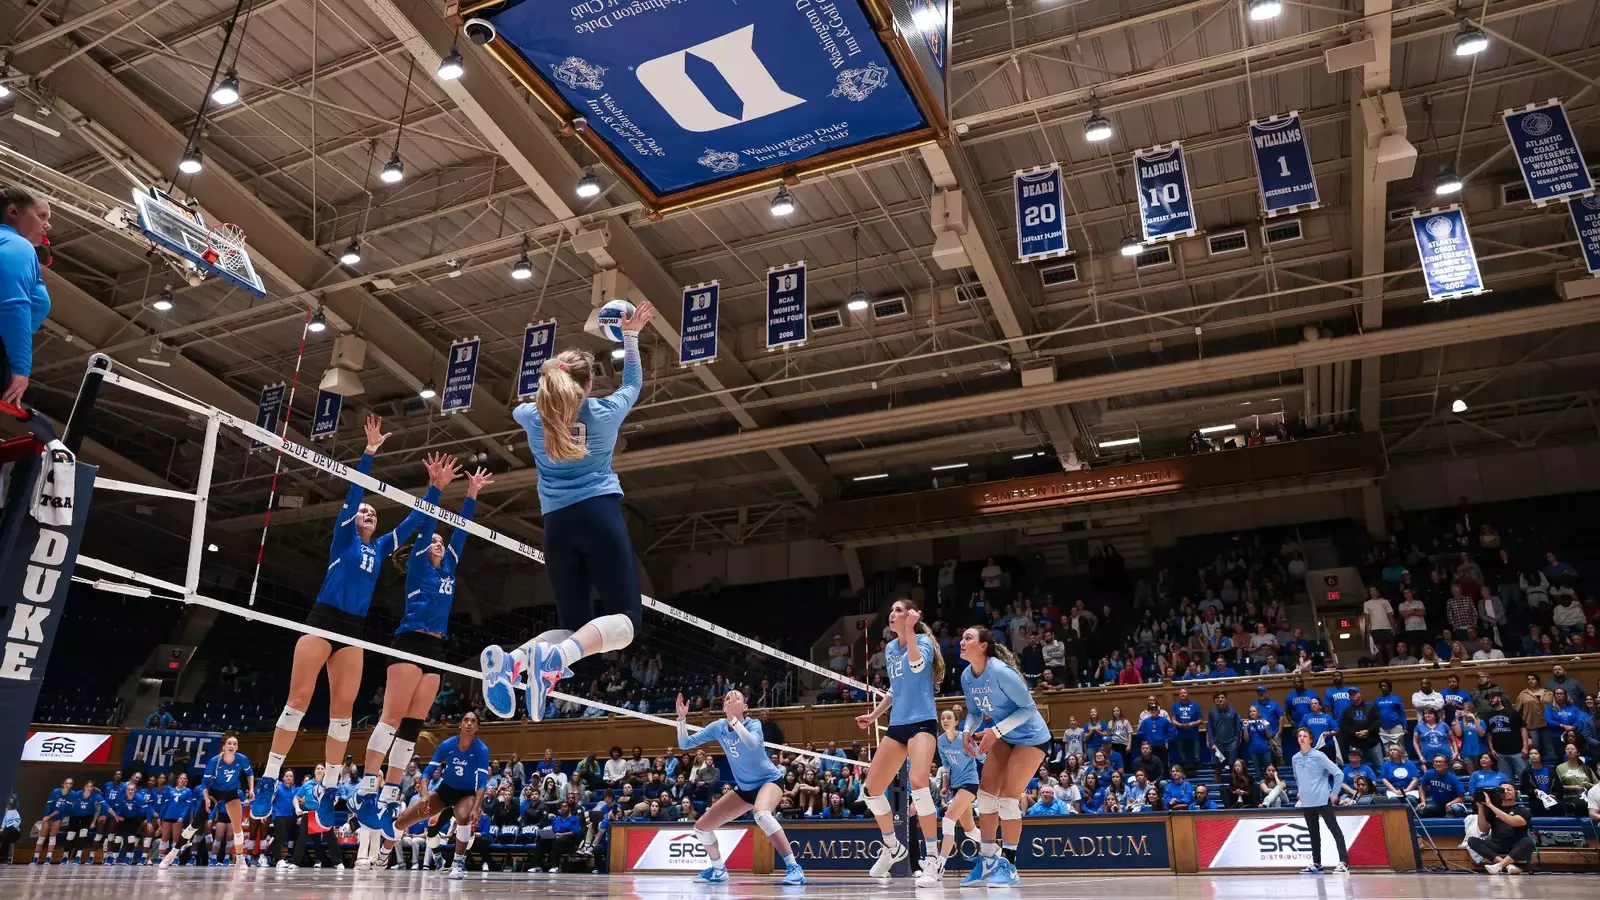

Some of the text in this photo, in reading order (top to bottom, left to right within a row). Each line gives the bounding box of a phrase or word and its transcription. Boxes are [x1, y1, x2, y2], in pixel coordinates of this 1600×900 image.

[820, 2, 843, 28] Golf
[574, 15, 613, 34] Duke
[836, 26, 850, 37] &
[806, 8, 844, 69] Washington
[845, 36, 861, 57] Inn
[586, 99, 650, 156] Inn & Golf Club
[600, 93, 665, 157] Washington Duke
[741, 121, 849, 156] Washington Duke
[753, 152, 777, 162] Inn
[789, 139, 817, 153] Golf
[818, 129, 849, 143] Club
[1255, 128, 1301, 149] WILLIAMS
[1525, 134, 1562, 148] ATLANTIC
[1523, 147, 1576, 164] CONFERENCE
[1533, 143, 1559, 154] COAST
[1141, 159, 1180, 178] HARDING
[1277, 155, 1291, 177] 1
[1532, 156, 1571, 170] WOMEN'S
[1530, 163, 1579, 178] CHAMPIONS
[1536, 172, 1579, 185] REGULAR SEASON
[1022, 180, 1055, 198] BEARD
[1265, 186, 1292, 198] DECEMBER
[1549, 181, 1573, 193] 1998
[1148, 182, 1180, 207] 10
[1025, 203, 1056, 227] 20
[1146, 214, 1169, 224] JANUARY
[1022, 234, 1043, 243] JANUARY
[1428, 237, 1460, 249] ATLANTIC
[1424, 249, 1470, 263] CONFERENCE
[1434, 244, 1456, 255] COAST
[1444, 281, 1465, 290] 2002
[778, 296, 794, 304] NCAA
[773, 304, 800, 315] WOMEN'S
[692, 313, 707, 323] NCAA
[770, 313, 803, 326] FINAL FOUR
[686, 322, 712, 333] WOMEN'S
[683, 331, 715, 343] FINAL FOUR
[530, 350, 543, 358] NCAA
[449, 374, 471, 384] WOMEN'S
[522, 369, 535, 377] FINAL
[458, 383, 472, 391] FOUR
[322, 398, 332, 416] 1
[282, 441, 348, 475] BLUE DEVILS
[983, 471, 1171, 504] CAMERON INDOOR STADIUM
[414, 497, 466, 527] BLUE DEVILS
[518, 542, 535, 558] BLUE
[360, 554, 375, 573] 11
[0, 528, 69, 681] DUKE
[669, 606, 682, 618] BLUE
[889, 660, 903, 679] 12
[1445, 695, 1463, 704] DUKE
[41, 742, 76, 754] SRS
[729, 746, 740, 759] 5
[225, 774, 233, 783] 7
[454, 766, 464, 777] 3
[669, 843, 708, 857] SRS
[788, 839, 885, 859] CAMERO
[1031, 834, 1151, 858] STADIUM
[1257, 834, 1313, 852] SRS
[1260, 853, 1312, 861] DISTRIBUTIO
